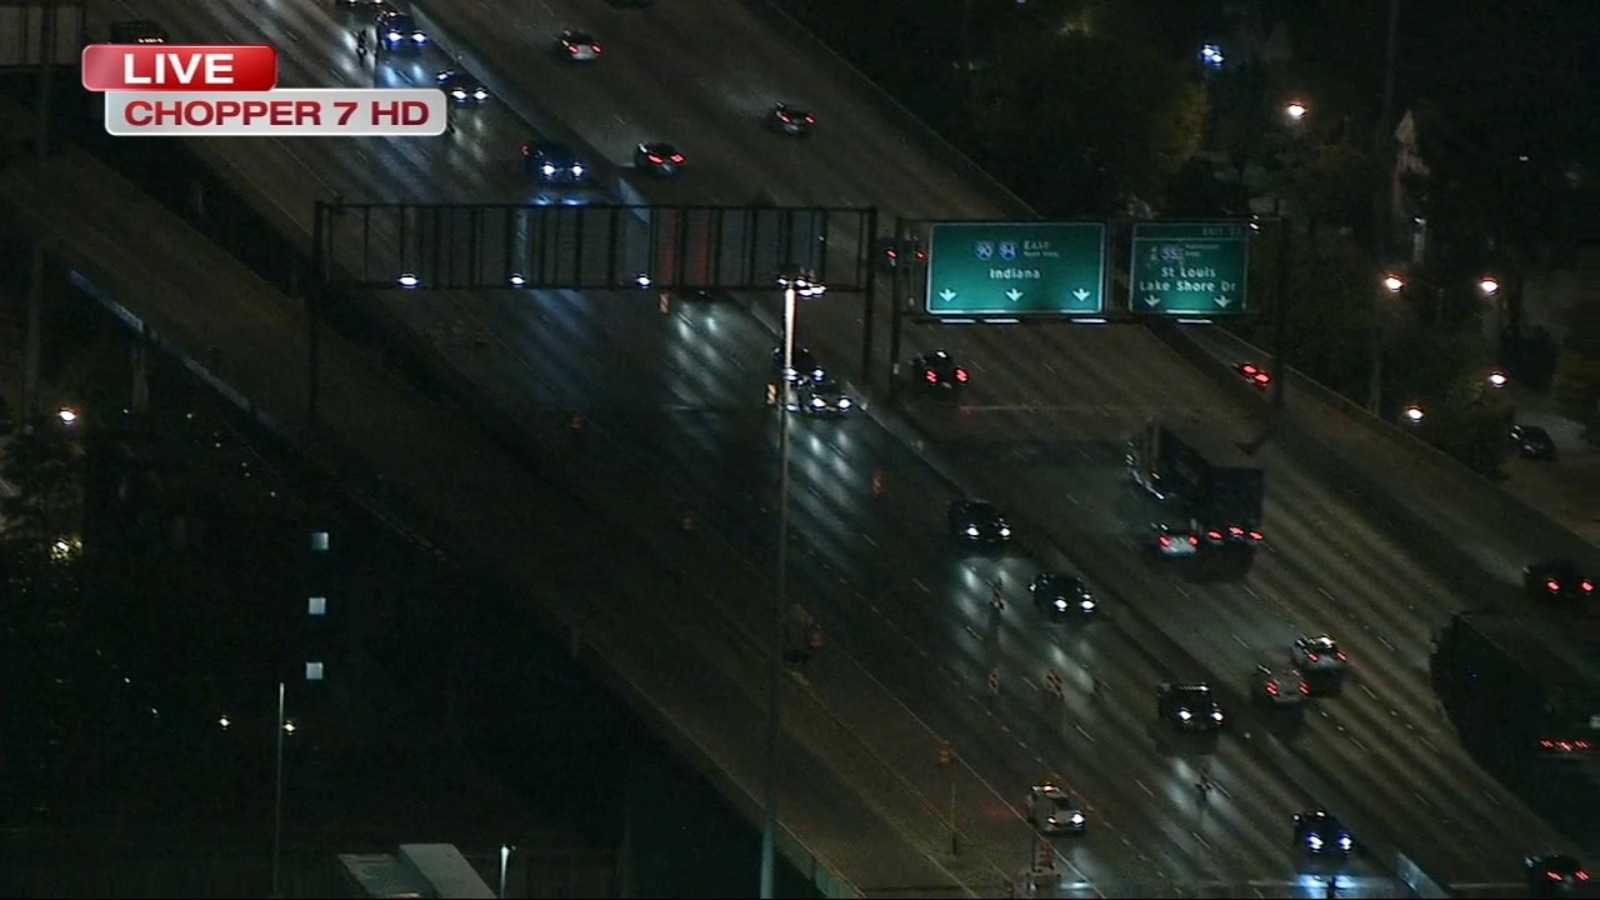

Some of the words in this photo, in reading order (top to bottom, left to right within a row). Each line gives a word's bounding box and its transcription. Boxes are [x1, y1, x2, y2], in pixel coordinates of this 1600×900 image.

[1023, 240, 1050, 250] EAST
[989, 267, 1041, 280] Indiana
[1160, 266, 1175, 278] St
[1179, 266, 1217, 278] Louis
[1139, 280, 1171, 292] Lake
[1176, 280, 1216, 292] Shore
[1220, 280, 1236, 292] Dr
